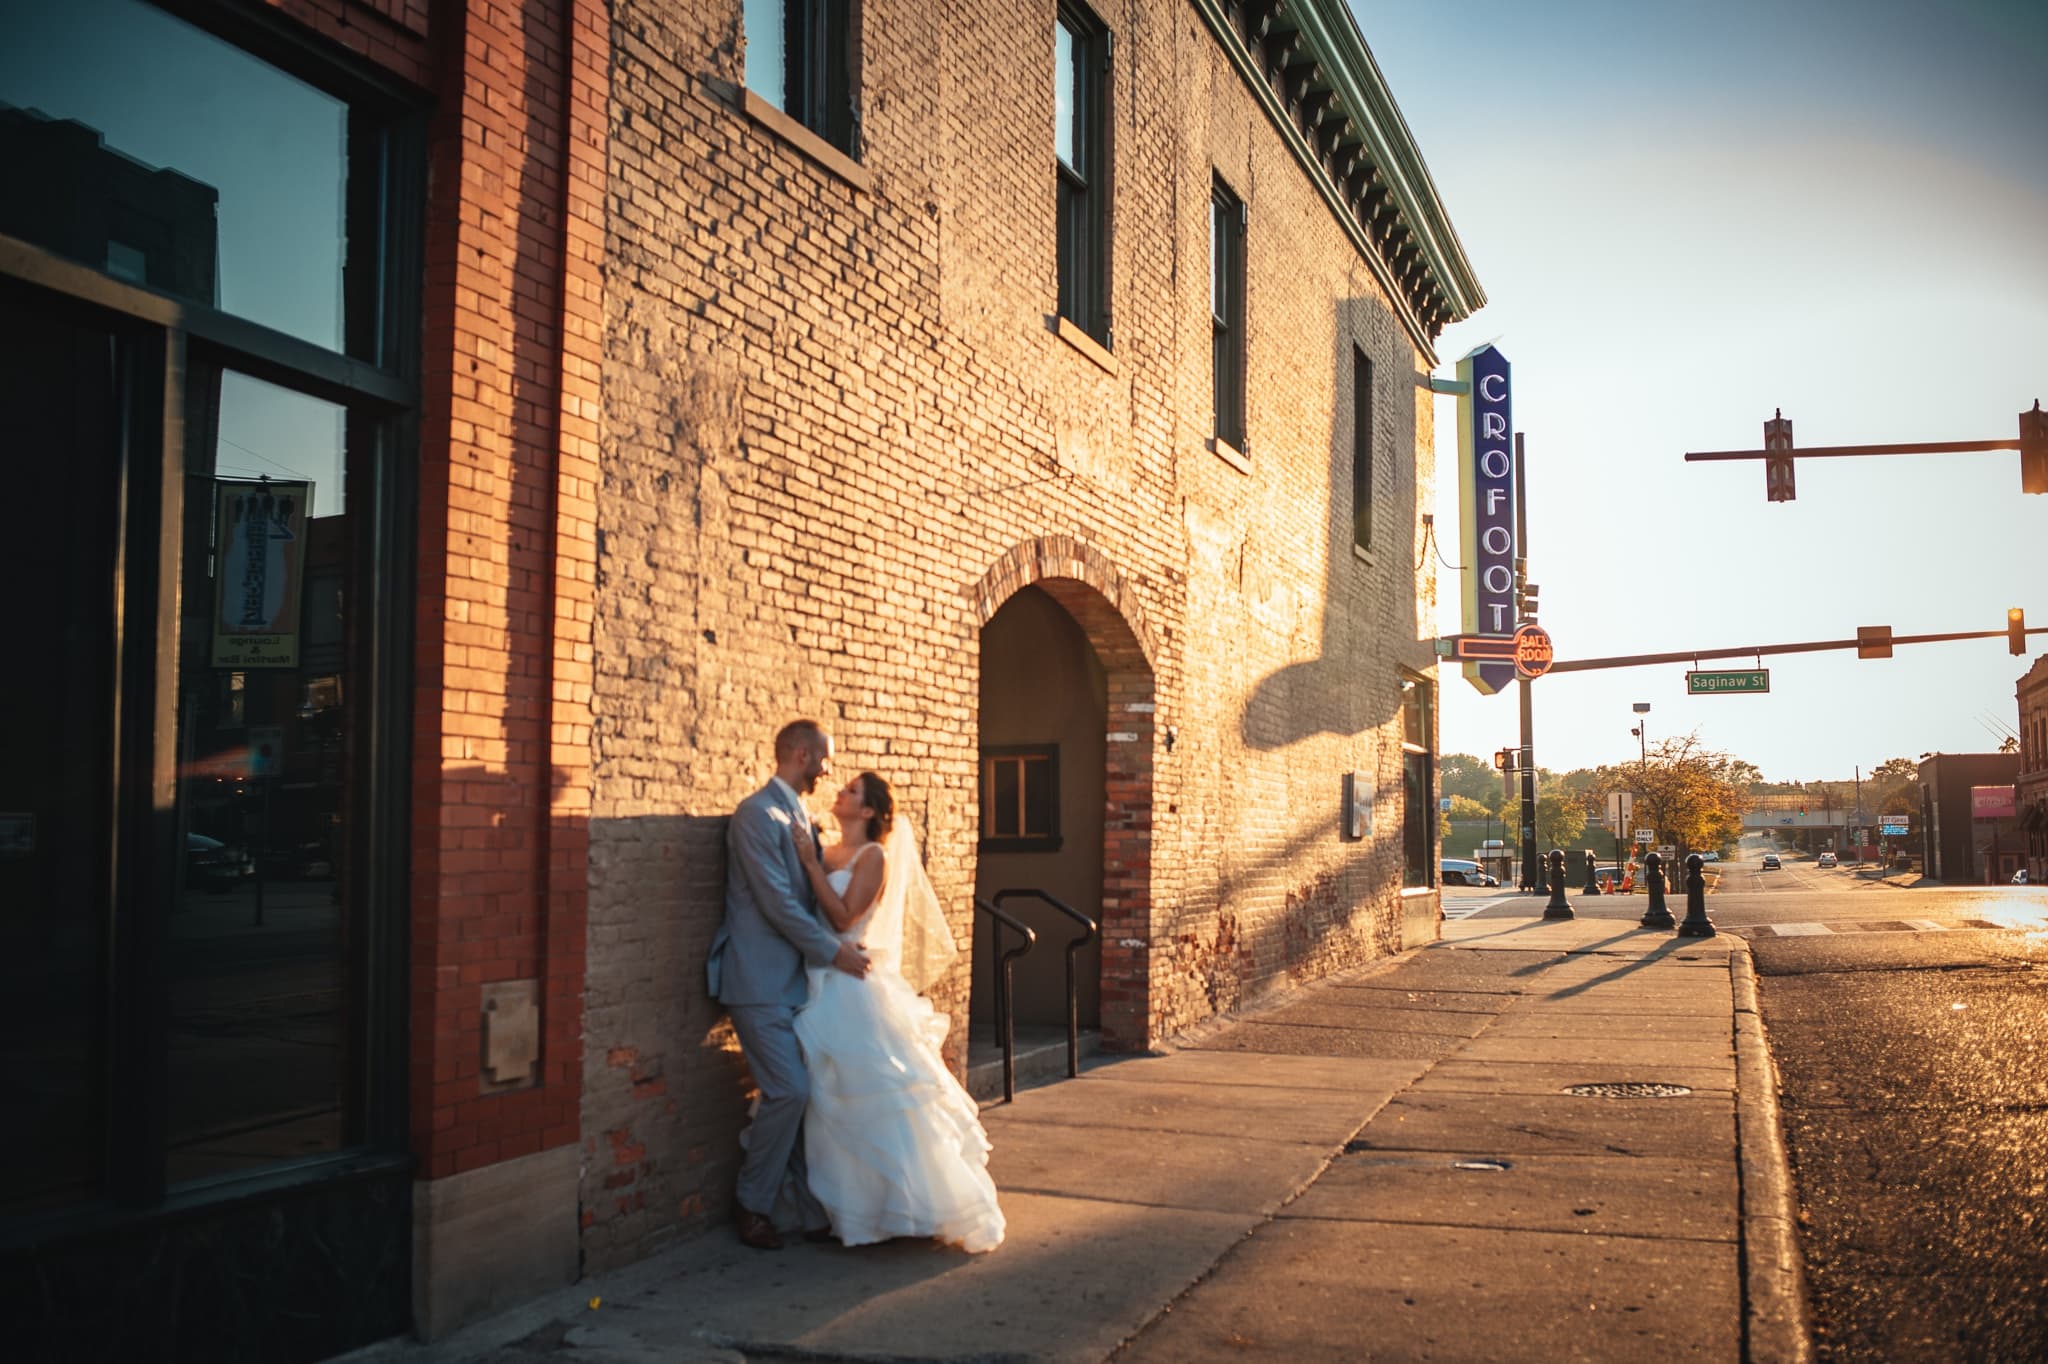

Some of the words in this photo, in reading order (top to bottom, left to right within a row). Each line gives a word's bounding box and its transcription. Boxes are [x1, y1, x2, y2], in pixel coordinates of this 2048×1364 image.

[1480, 374, 1511, 632] CROFOOT
[1520, 635, 1549, 648] BALL
[1518, 648, 1552, 661] ROOM
[1693, 676, 1747, 690] Saginaw
[1752, 676, 1764, 686] St
